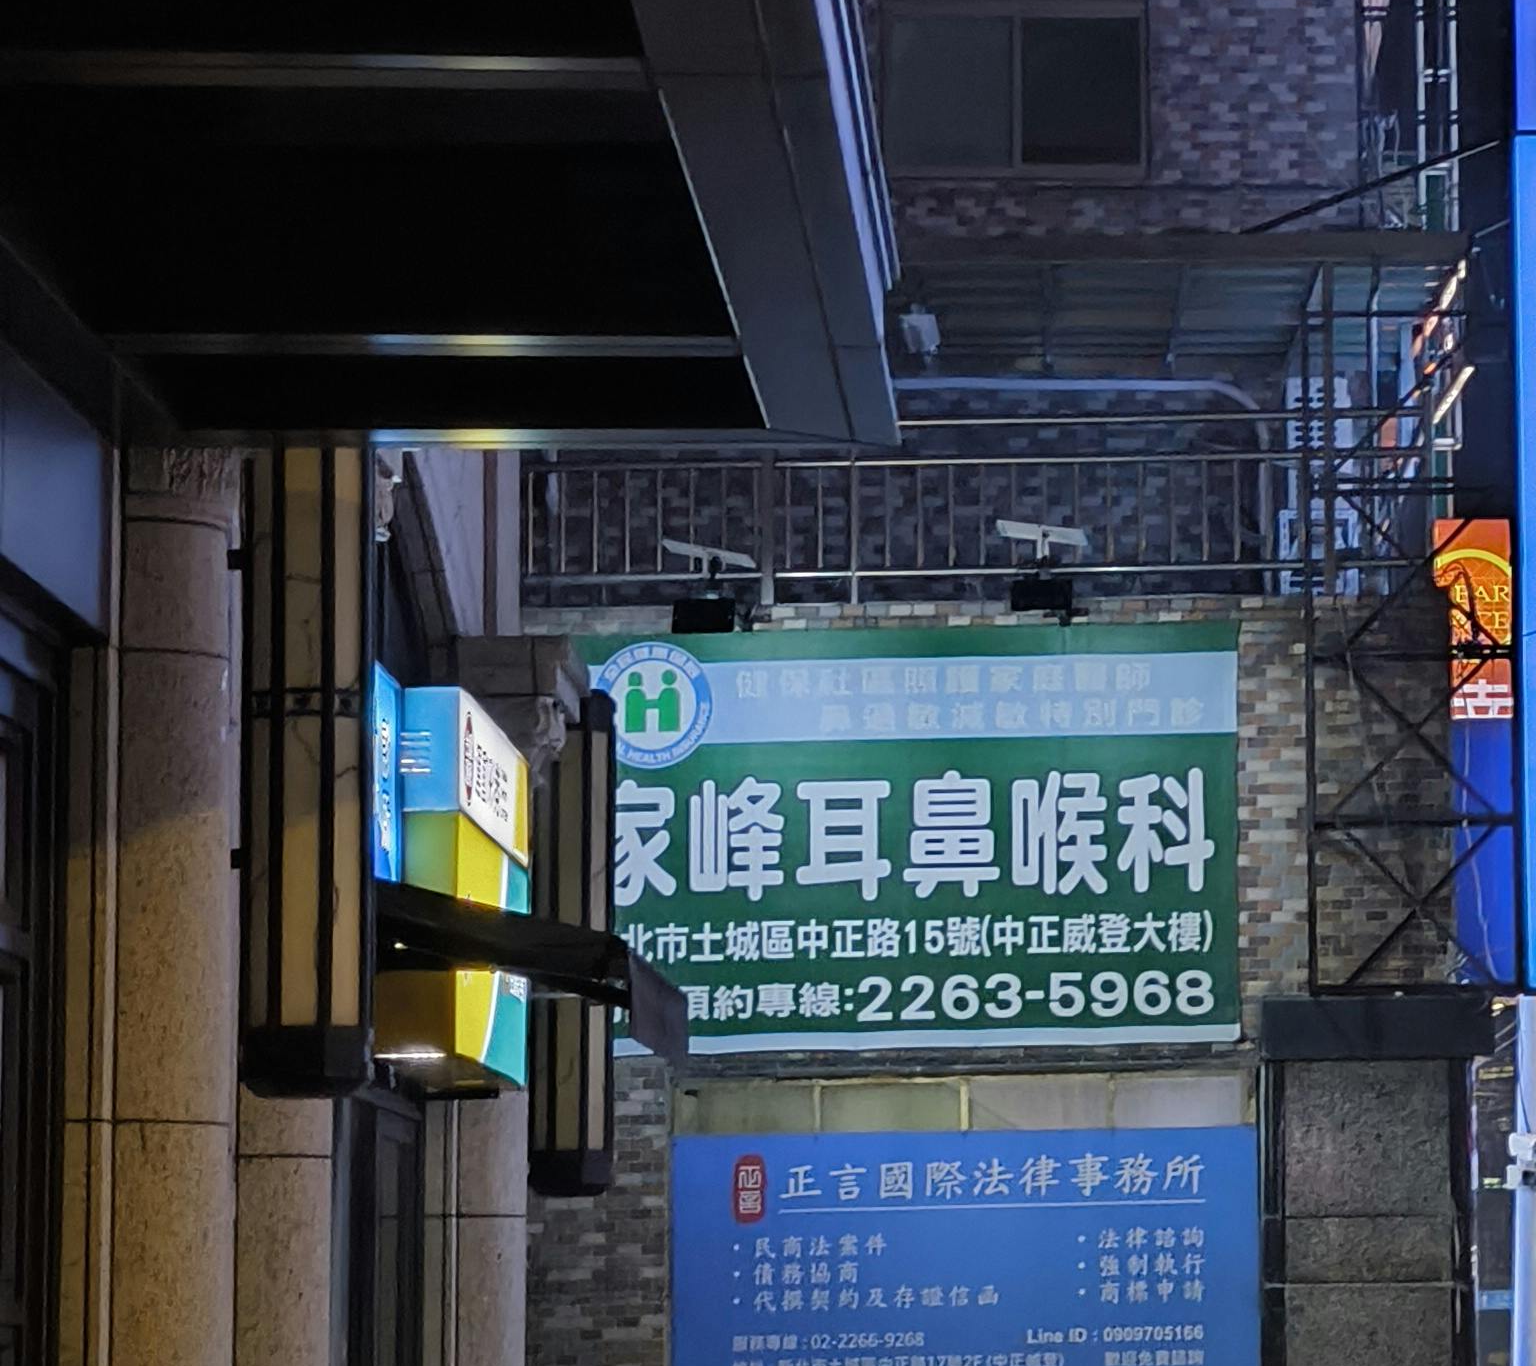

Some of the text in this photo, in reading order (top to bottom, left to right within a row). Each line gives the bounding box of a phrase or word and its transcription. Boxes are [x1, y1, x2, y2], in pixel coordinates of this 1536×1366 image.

[613, 766, 1216, 907] 家峰耳鼻喉科
[778, 1152, 1205, 1200] 正言國際法律事務所
[753, 1233, 888, 1259] 民商法案件
[753, 1261, 860, 1286] 債務協商
[1026, 1328, 1064, 1345] Line
